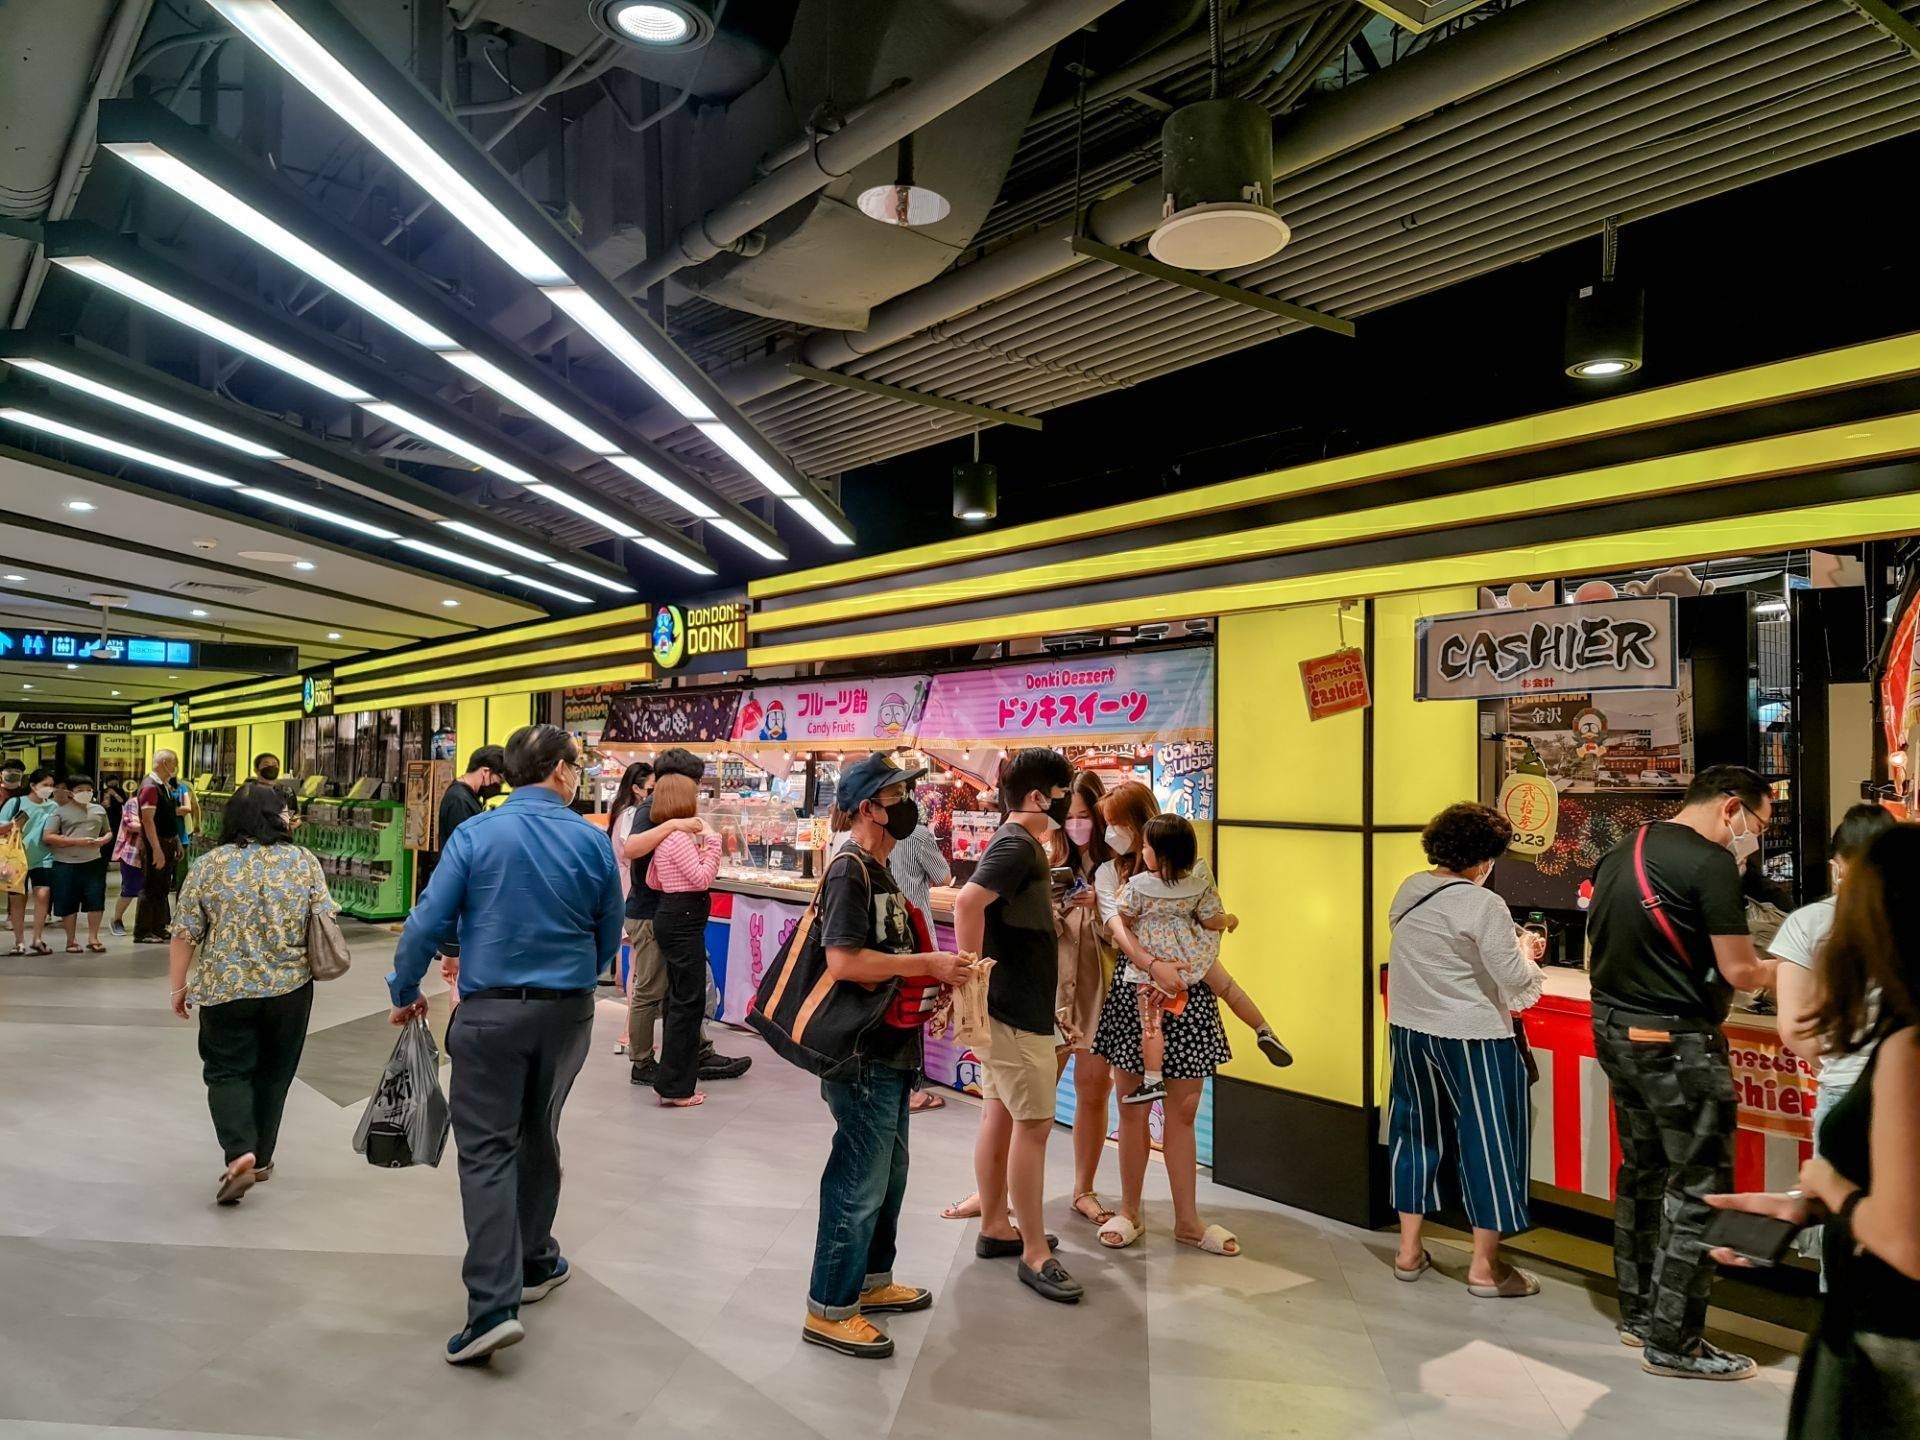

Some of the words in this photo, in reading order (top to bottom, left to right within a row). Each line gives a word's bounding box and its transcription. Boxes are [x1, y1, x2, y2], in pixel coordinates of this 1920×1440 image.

[688, 621, 740, 655] DONKI
[1438, 617, 1657, 681] CASHIER
[1026, 671, 1060, 690] Donki
[1061, 667, 1117, 687] Dezzert
[1521, 677, 1555, 689] お会計
[797, 688, 869, 718] フルーツ飴
[1311, 679, 1364, 707] Cashier
[998, 690, 1149, 729] ドンキスイーツ
[1530, 706, 1562, 724] 金沢
[19, 721, 54, 730] Arcade
[57, 722, 88, 731] Crown
[90, 722, 131, 732] Exchang
[807, 721, 830, 736] Candy
[832, 721, 856, 734] Fruits
[1513, 833, 1546, 847] o.23
[1733, 1076, 1818, 1117] shier
